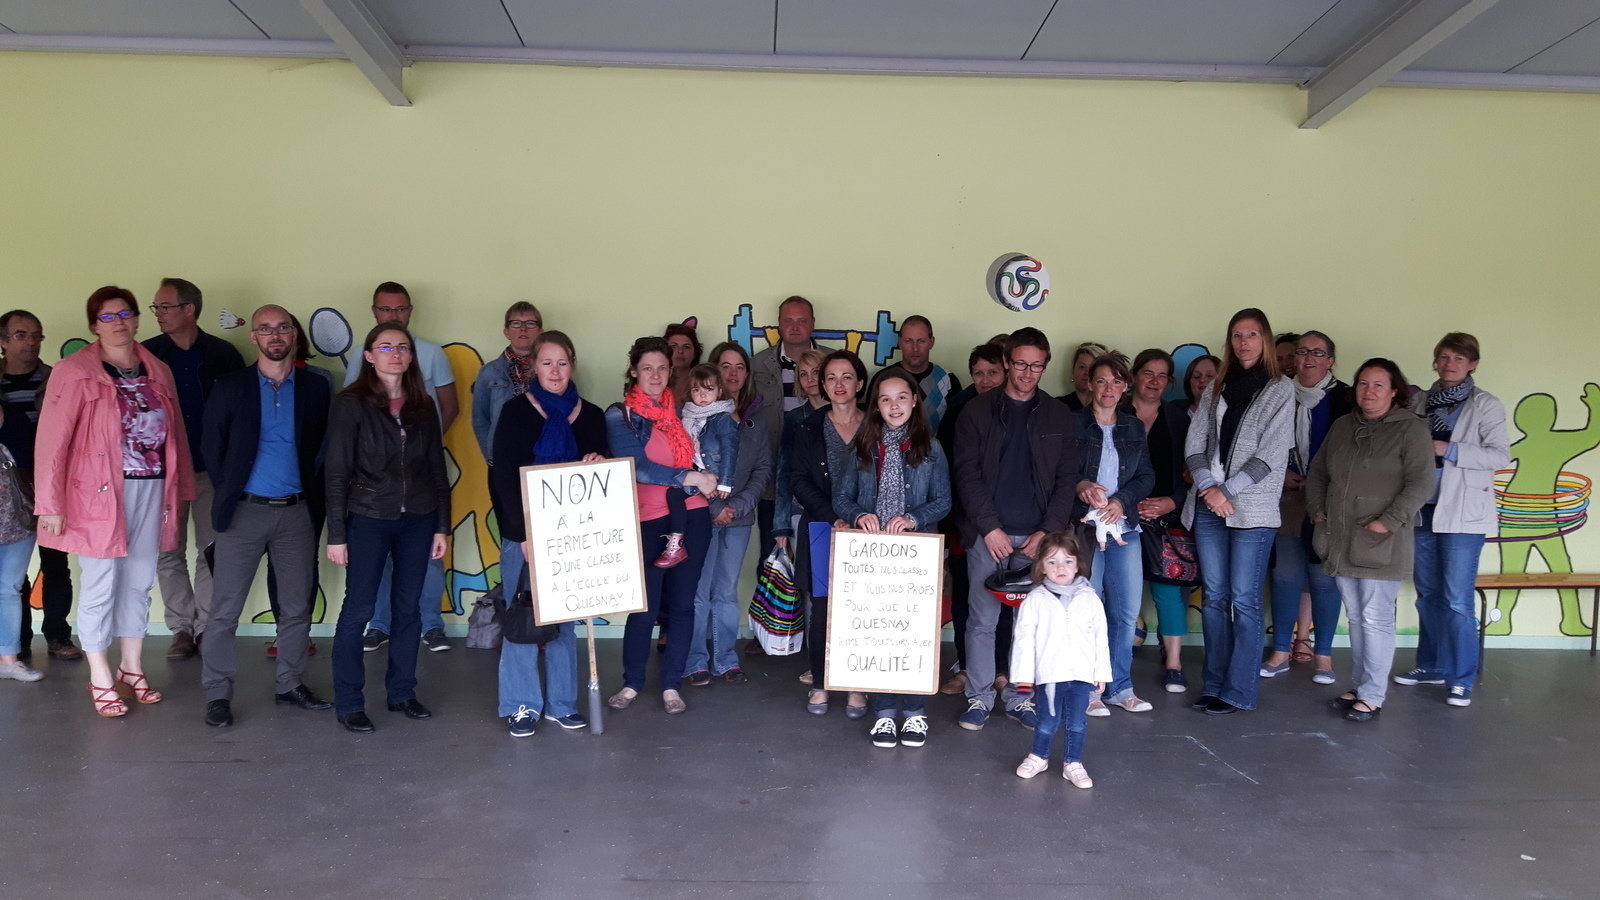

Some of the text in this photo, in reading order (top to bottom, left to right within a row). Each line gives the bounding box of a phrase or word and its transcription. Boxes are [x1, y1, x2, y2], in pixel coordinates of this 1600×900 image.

[541, 469, 611, 509] NON
[579, 510, 594, 524] LA
[546, 528, 625, 556] FERMETURE
[849, 538, 918, 559] GARDONS
[551, 552, 622, 576] D'UNE CLASSE
[842, 561, 875, 574] TOUTES
[615, 572, 629, 584] DU
[843, 581, 857, 593] ET
[906, 582, 935, 596] PROFS
[844, 599, 870, 612] POUR
[906, 603, 920, 613] LE
[851, 617, 910, 631] QUESNAY
[847, 653, 910, 672] QUALITÉ
